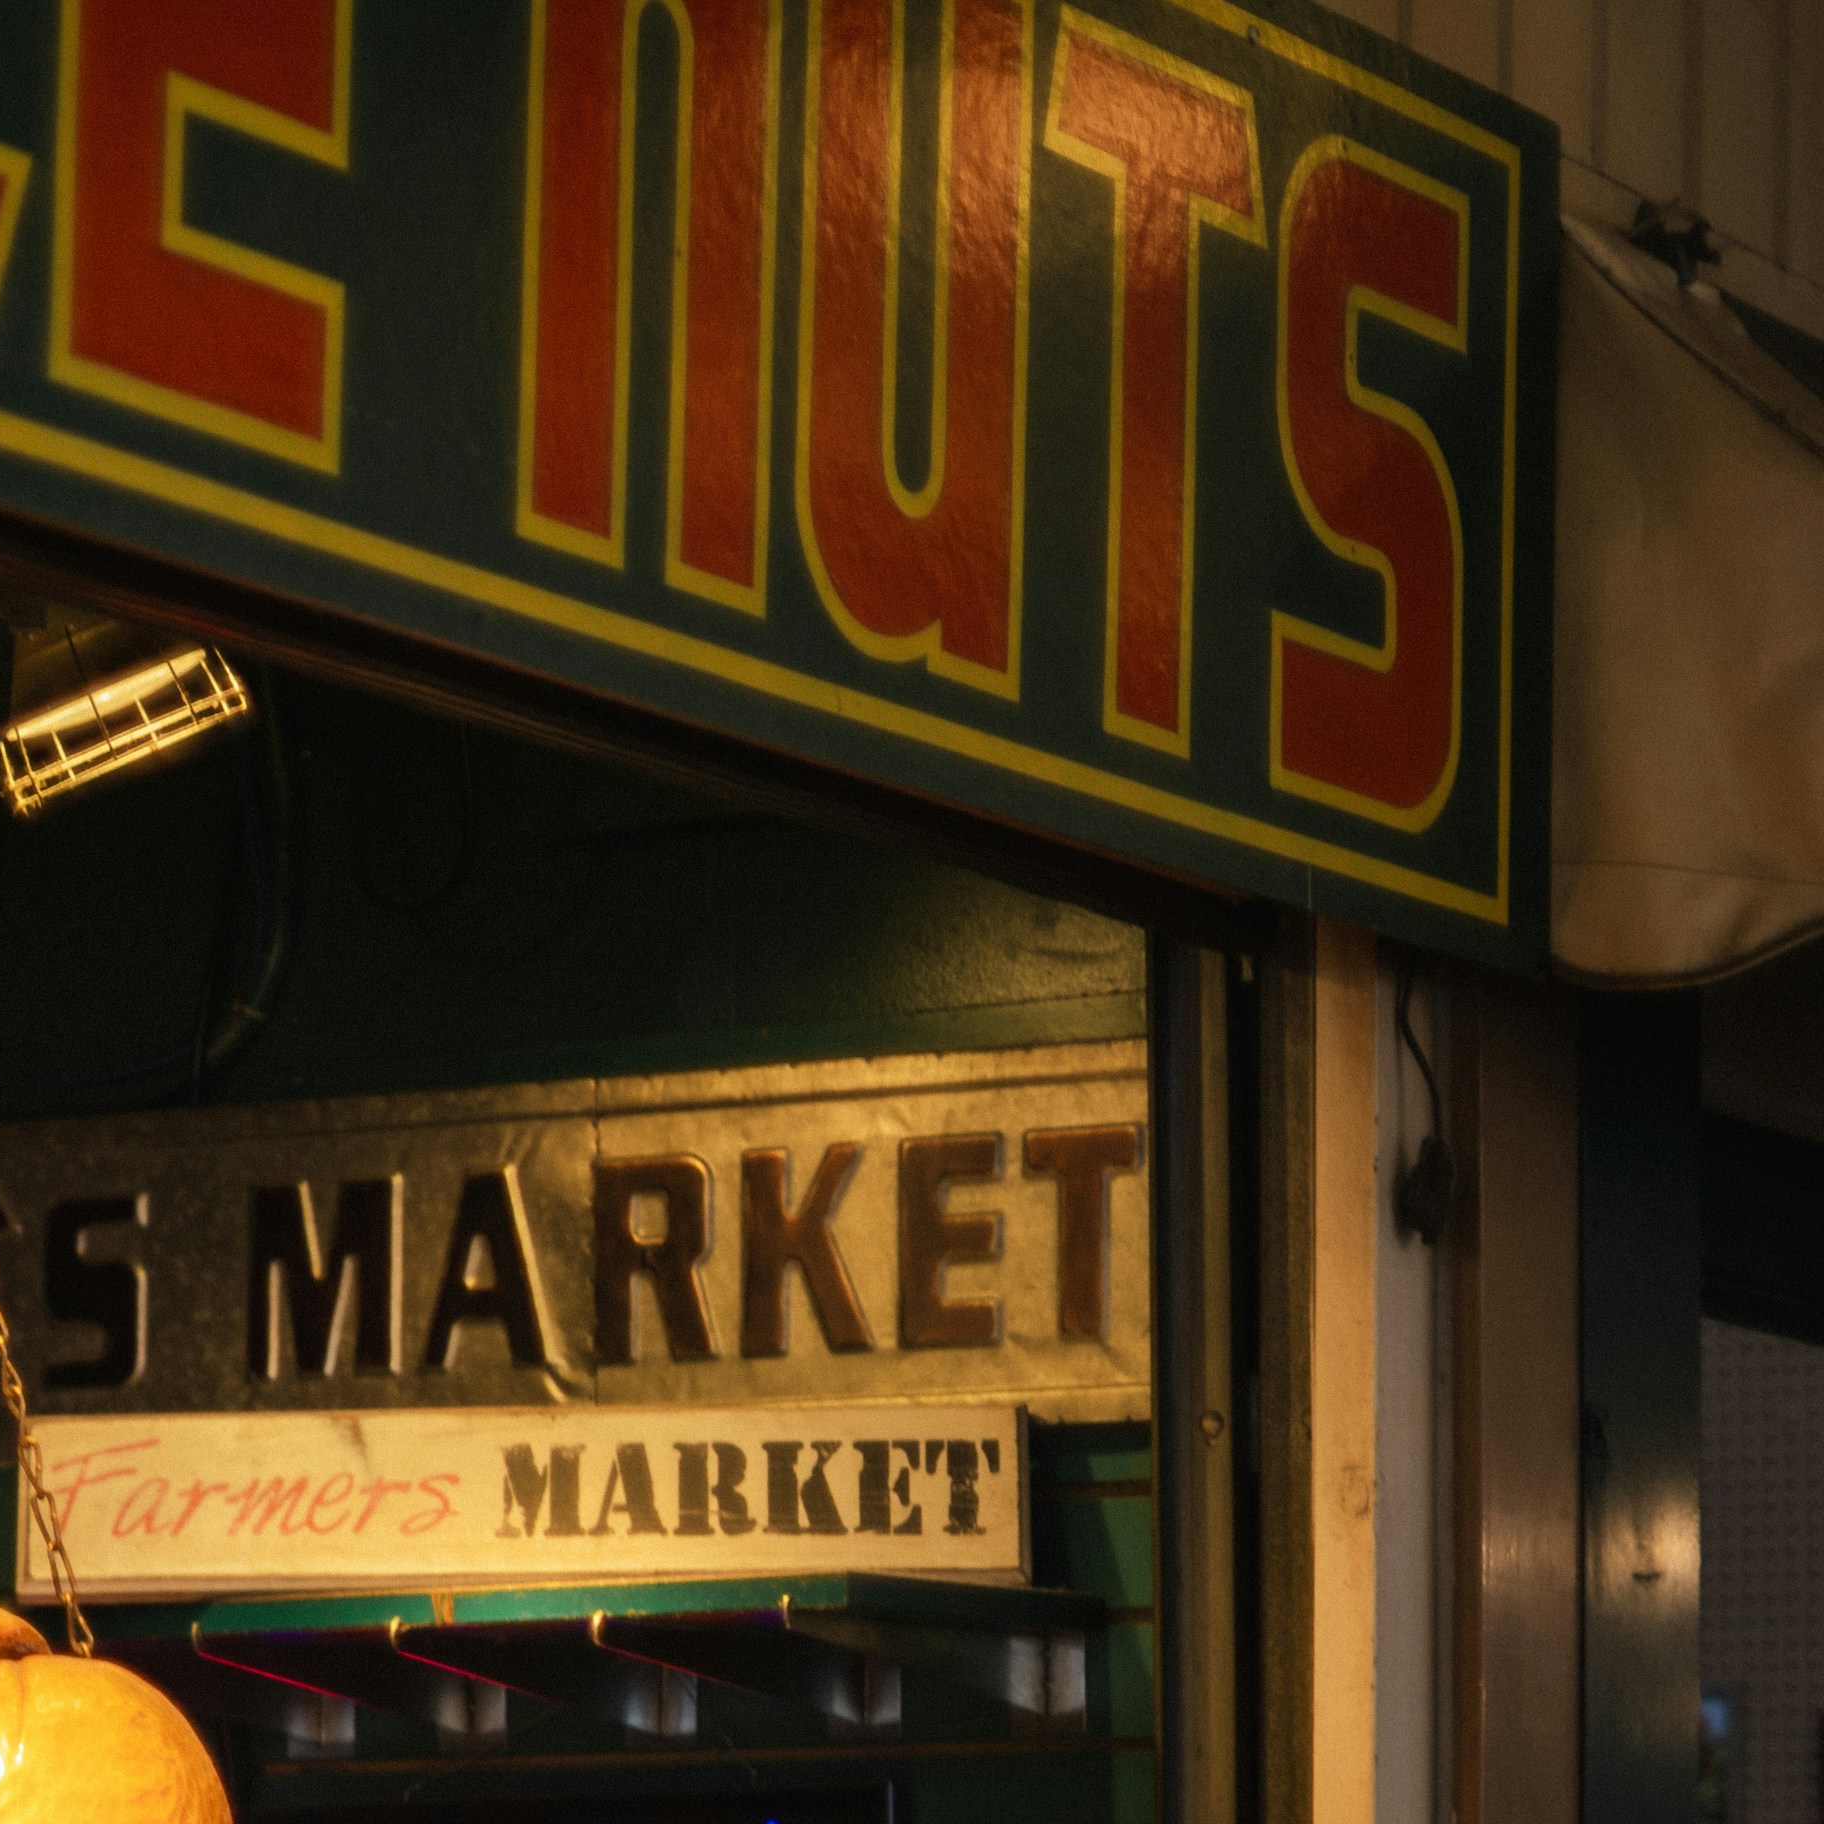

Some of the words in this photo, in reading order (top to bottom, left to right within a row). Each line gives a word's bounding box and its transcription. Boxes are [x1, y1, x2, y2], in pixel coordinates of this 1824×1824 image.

[514, 0, 1466, 837] NUTS
[245, 1120, 1144, 1378] MARKET
[45, 1437, 462, 1541] Farmers
[494, 1437, 1000, 1539] MARKET
